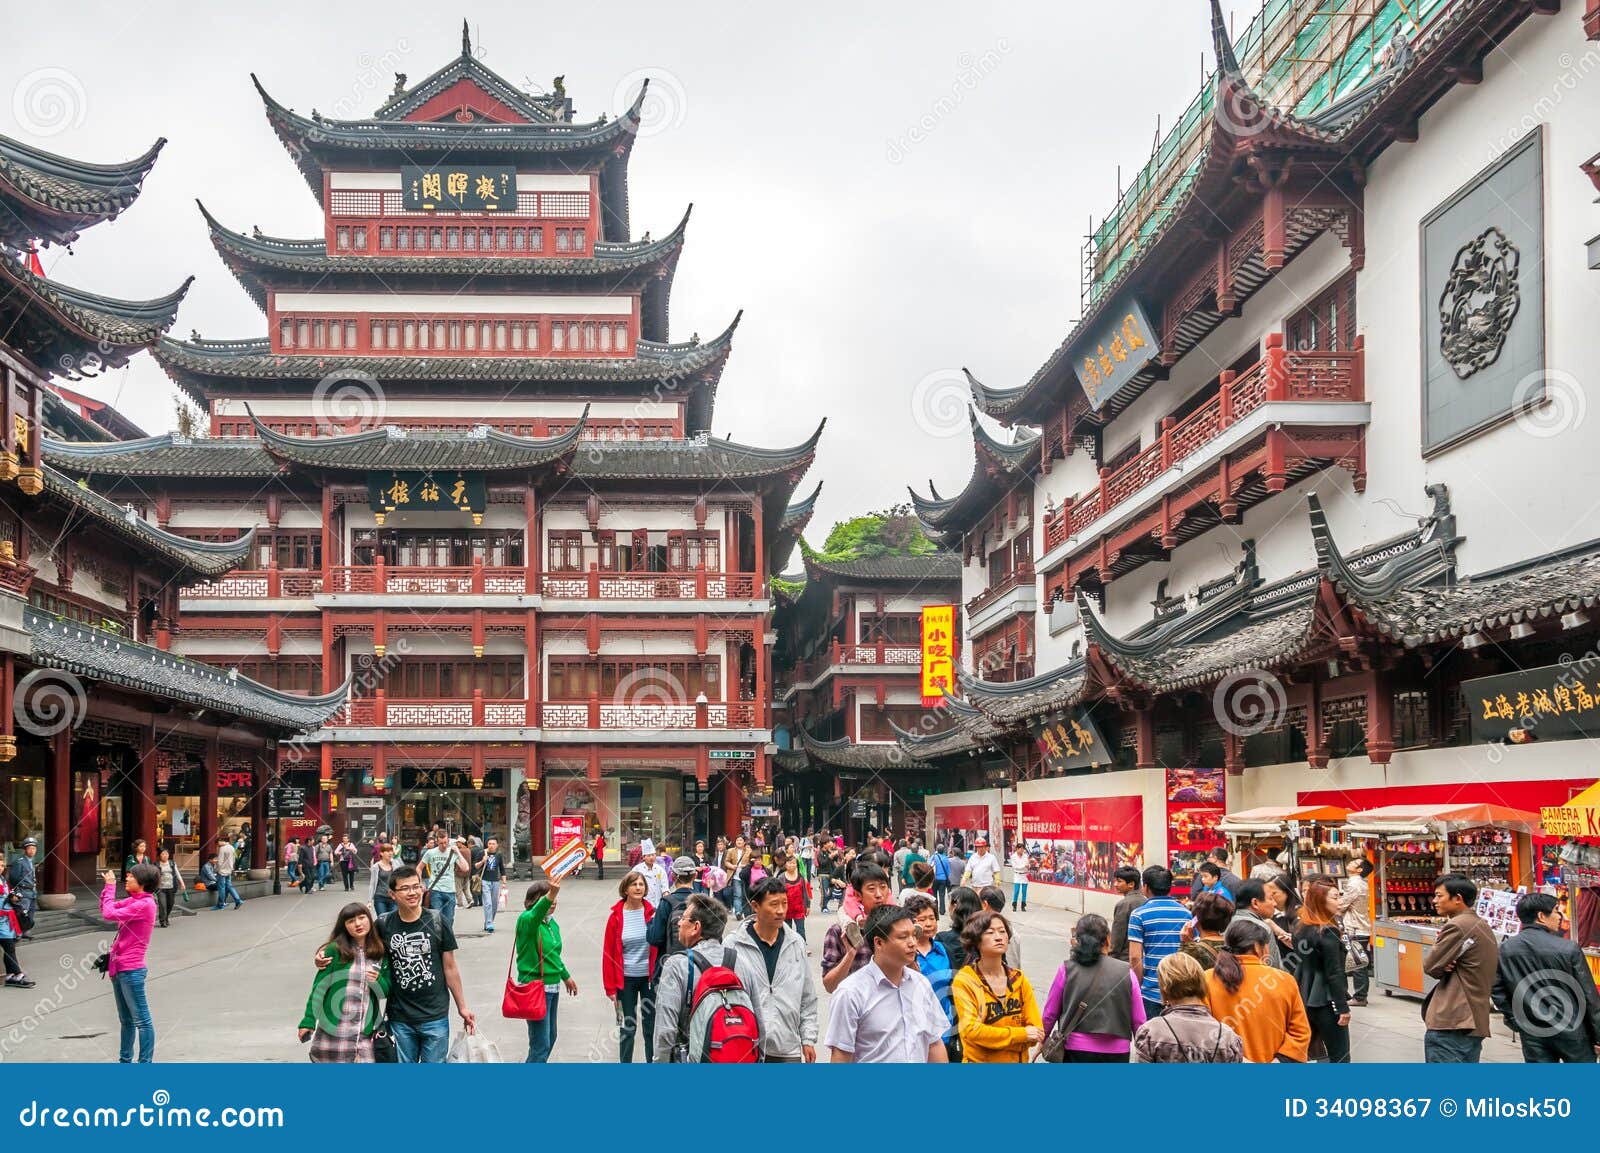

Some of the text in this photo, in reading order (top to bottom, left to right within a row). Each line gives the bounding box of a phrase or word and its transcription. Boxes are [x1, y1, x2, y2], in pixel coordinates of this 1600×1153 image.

[927, 628, 949, 689] 小吃广场
[1541, 807, 1580, 821] CAMERA
[1543, 822, 1583, 835] POSTCARD
